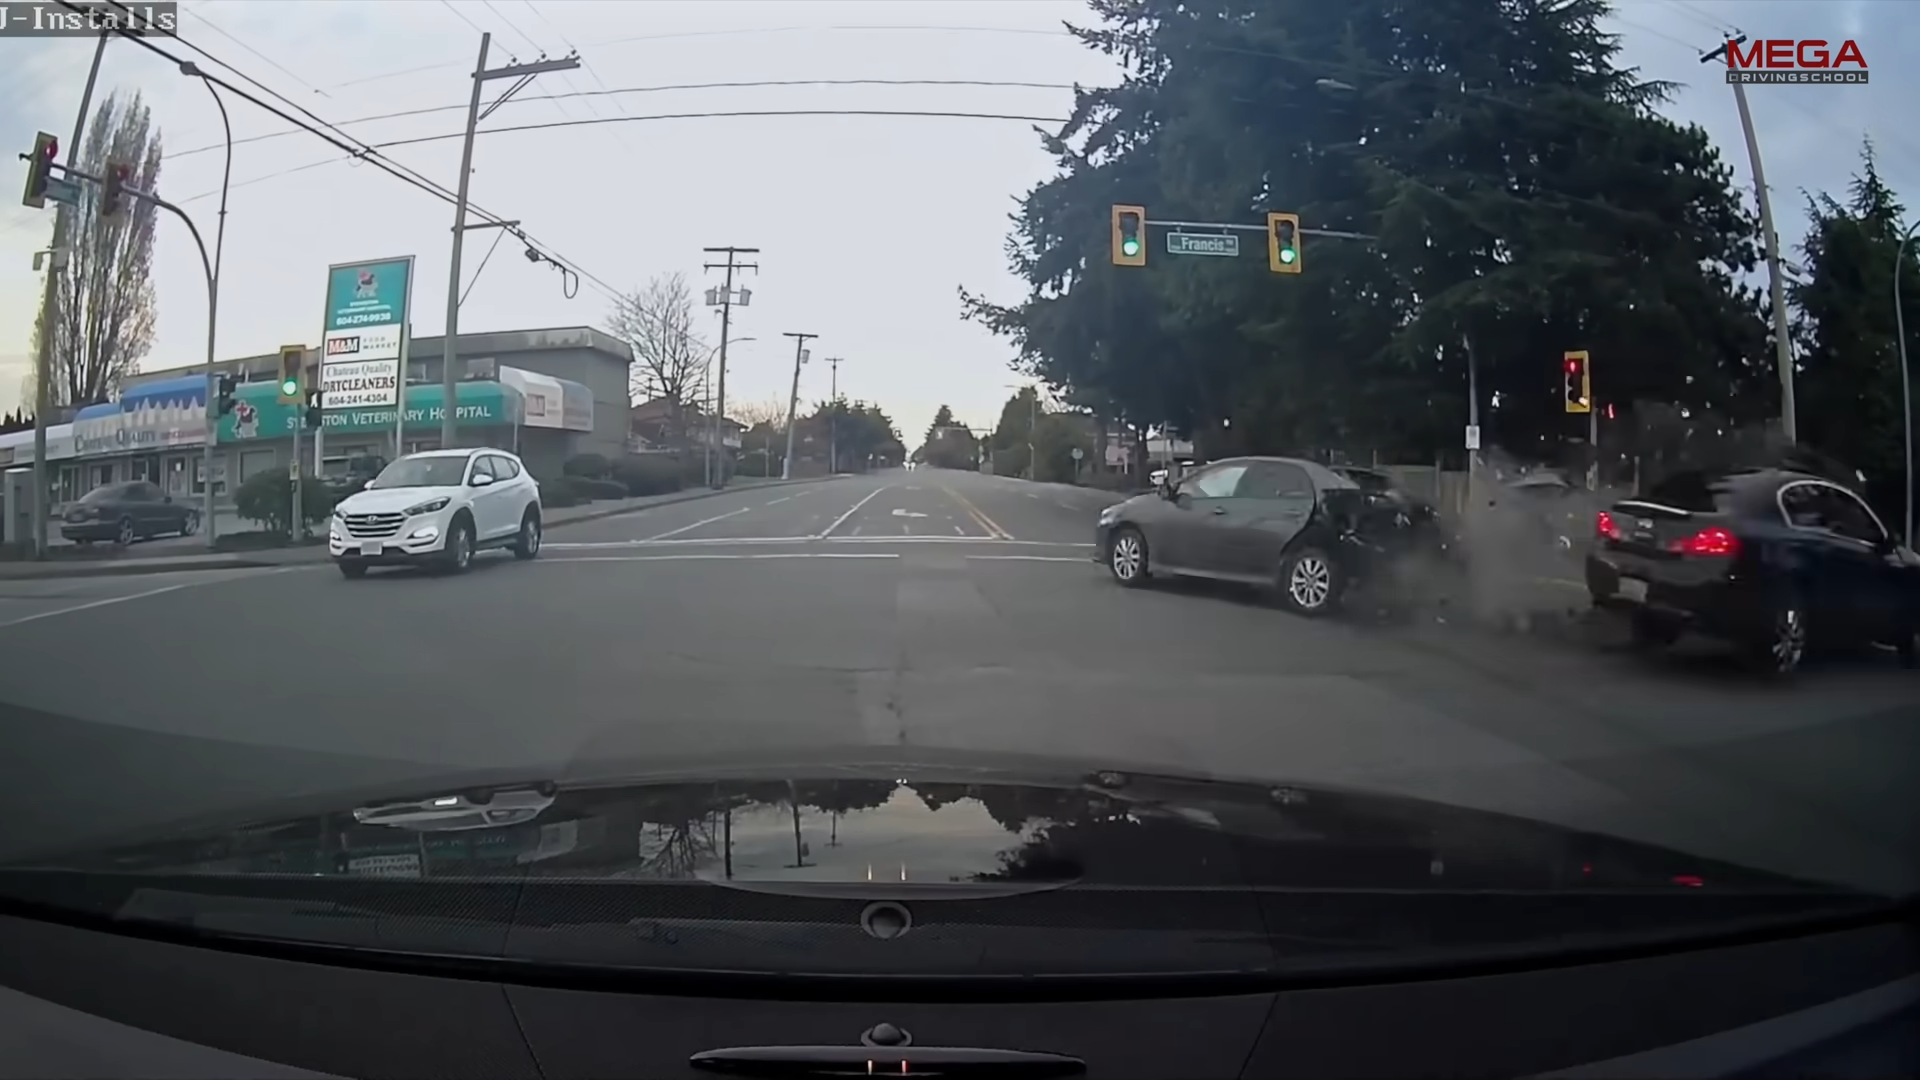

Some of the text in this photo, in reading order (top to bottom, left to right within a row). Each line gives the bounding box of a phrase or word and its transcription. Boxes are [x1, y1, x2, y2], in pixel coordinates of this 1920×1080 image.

[1181, 236, 1225, 252] Francis
[328, 337, 359, 354] M&M
[326, 362, 391, 377] Chateau Quality
[328, 393, 388, 406] 604-241-4304
[286, 414, 347, 430] STESTON
[430, 405, 492, 420] HOPITAL
